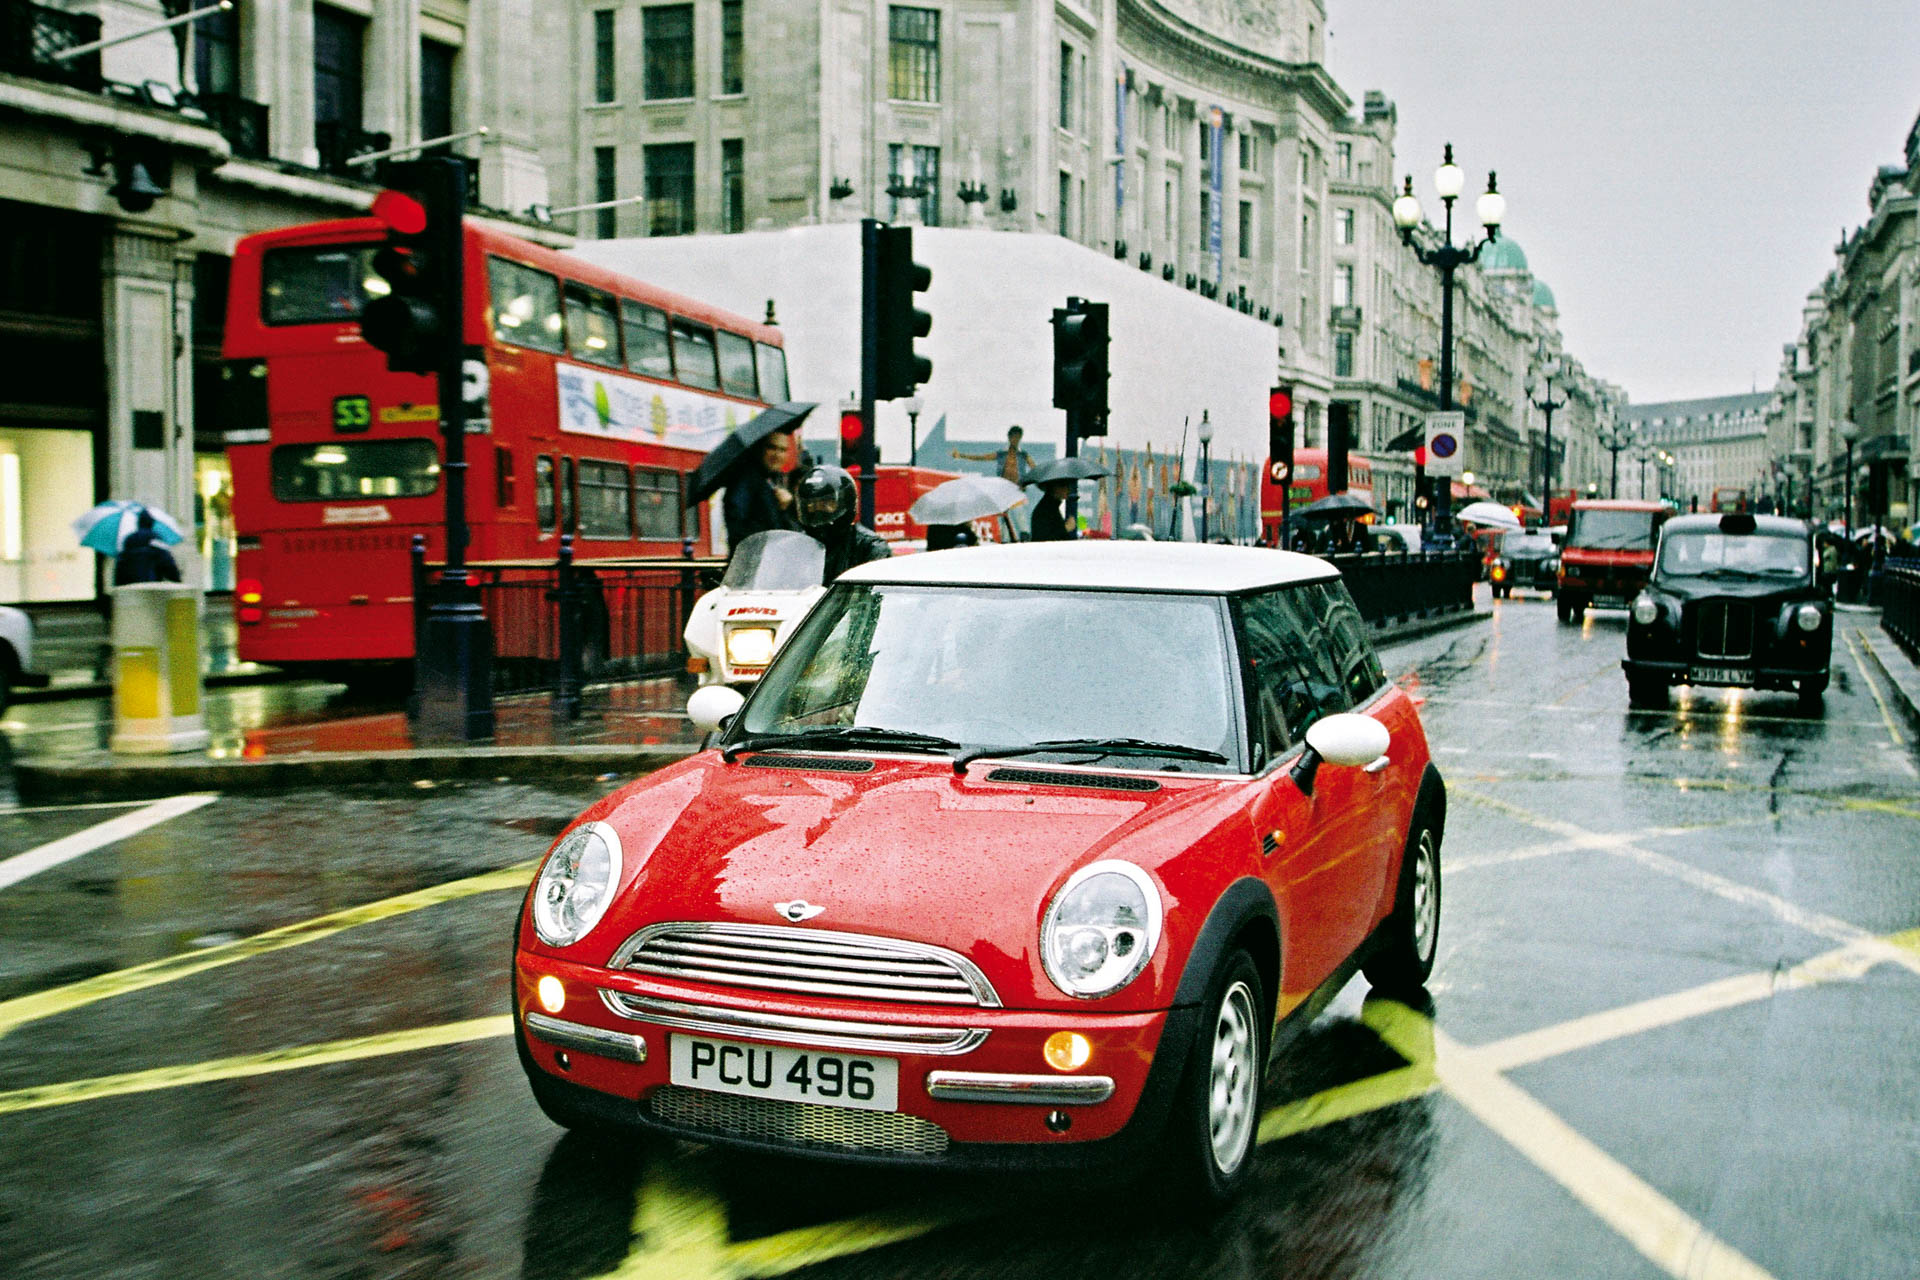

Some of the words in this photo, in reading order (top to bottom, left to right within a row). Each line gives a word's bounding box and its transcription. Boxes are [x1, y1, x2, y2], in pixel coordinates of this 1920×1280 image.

[335, 399, 370, 426] 53
[874, 512, 905, 526] ORCE
[691, 1041, 773, 1089] PCU
[786, 1055, 875, 1101] 496
